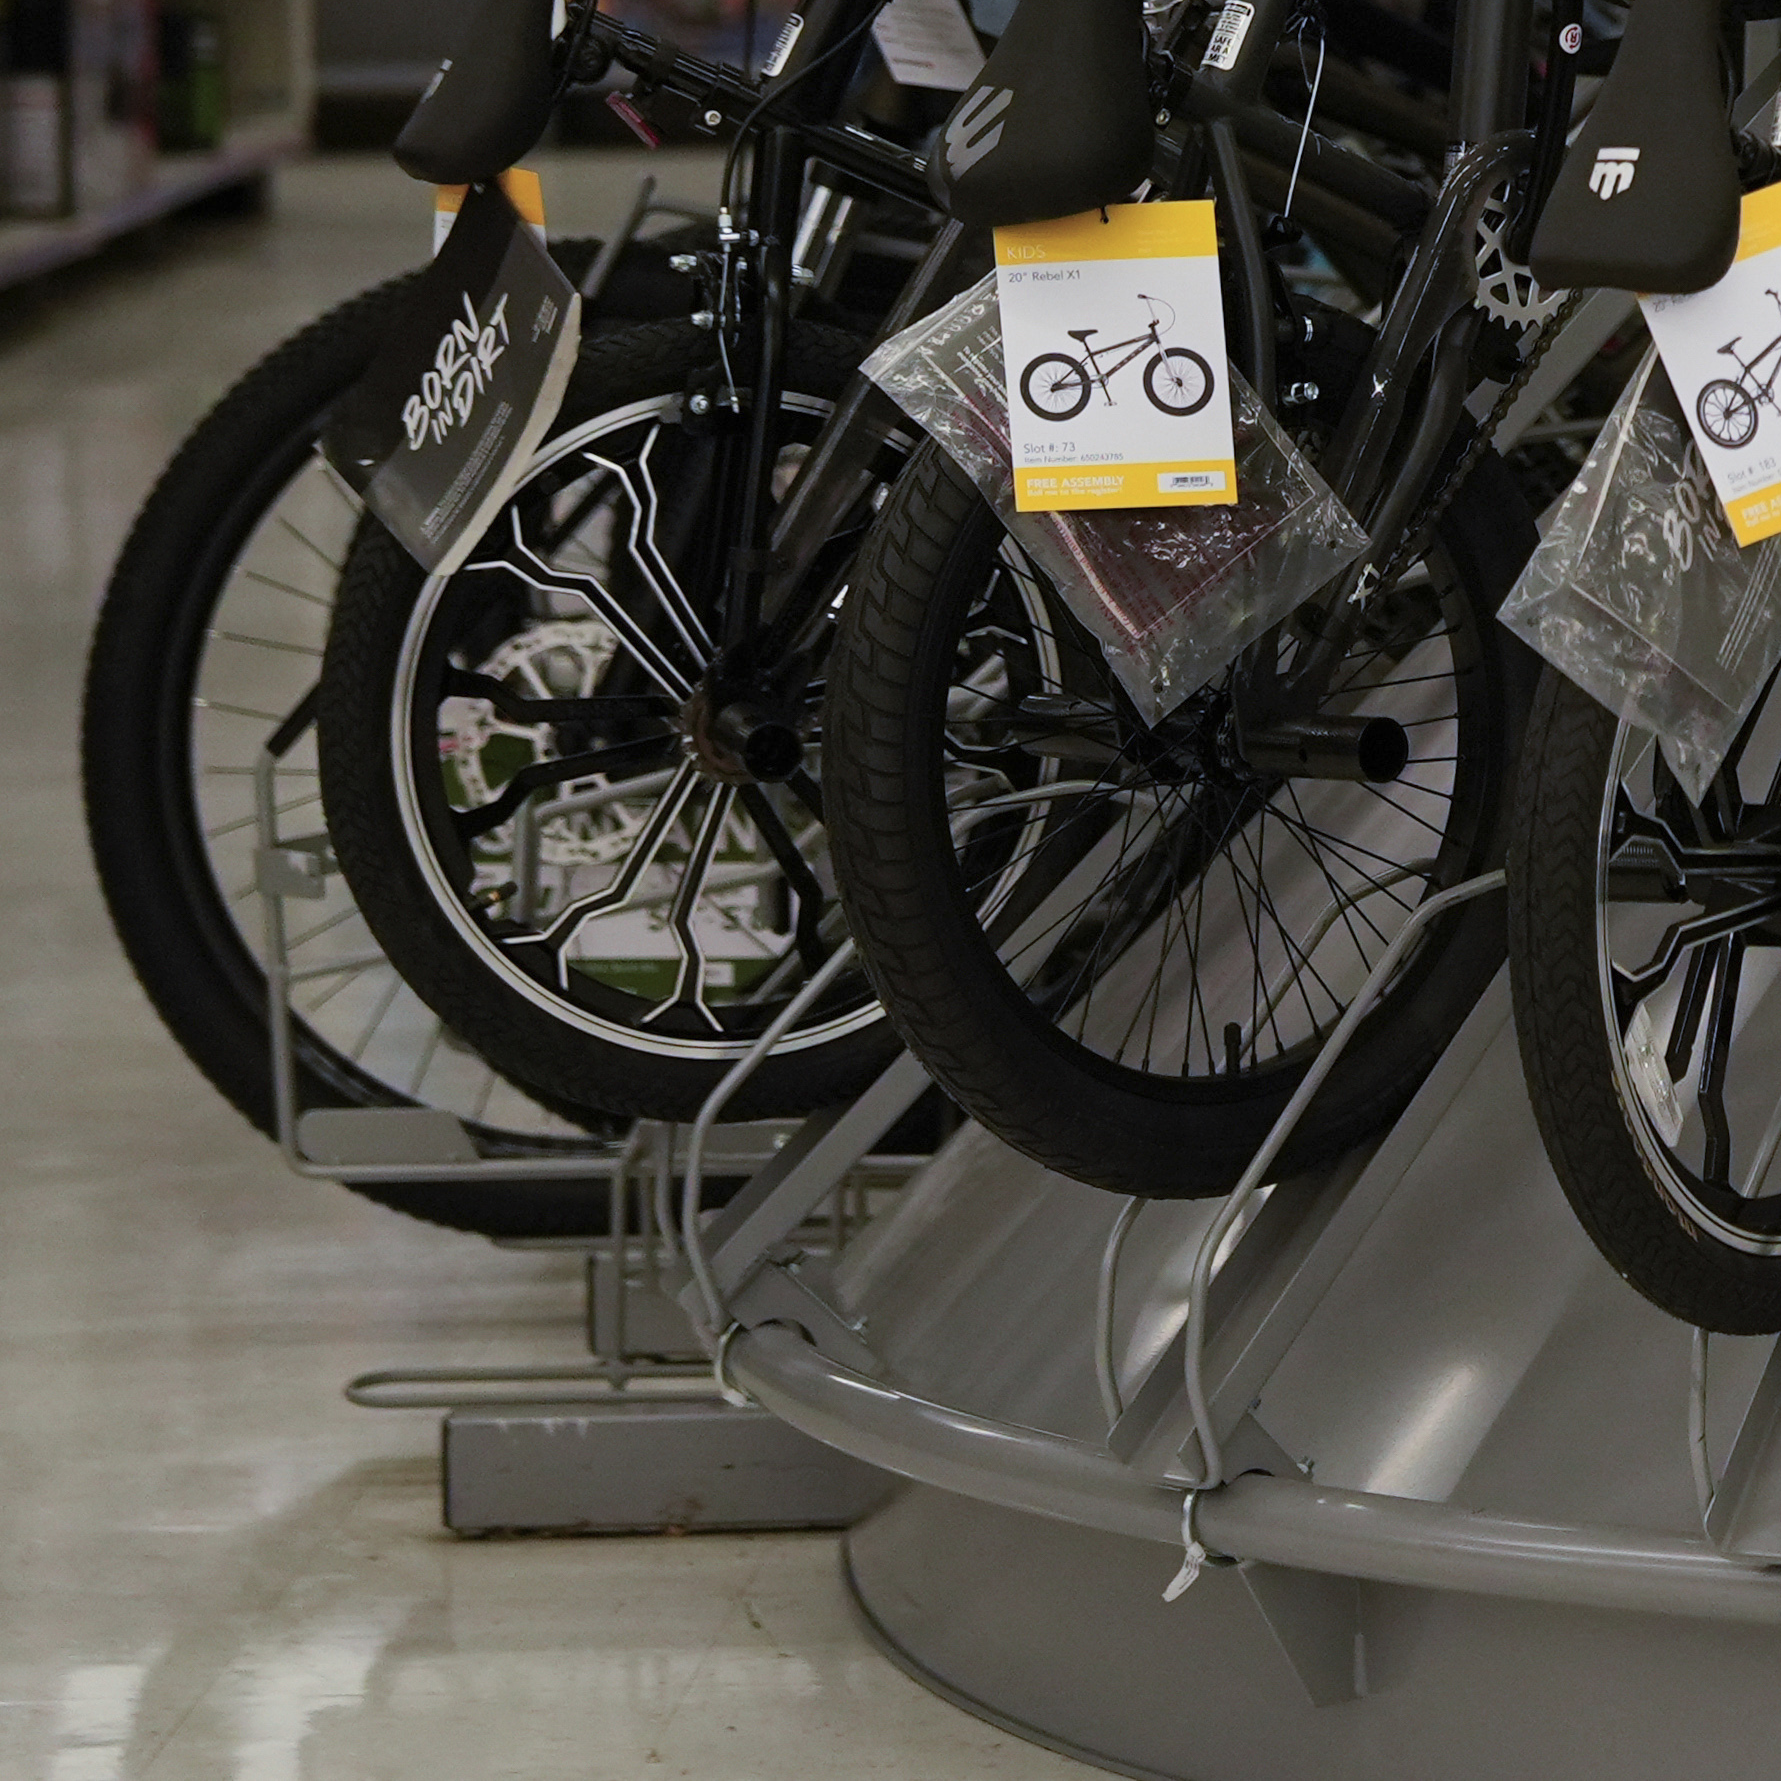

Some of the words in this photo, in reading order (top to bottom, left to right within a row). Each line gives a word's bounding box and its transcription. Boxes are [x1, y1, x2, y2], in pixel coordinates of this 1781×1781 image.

[1006, 245, 1047, 259] KIDS
[1032, 270, 1064, 282] Rebel
[1067, 269, 1081, 280] X1
[402, 290, 479, 451] BORN
[431, 396, 454, 445] IN
[452, 293, 510, 428] DIRT
[1023, 443, 1045, 454] Slot
[1062, 442, 1076, 452] 73
[1728, 470, 1745, 483] Slot
[1758, 458, 1776, 470] 183
[1027, 478, 1057, 489] FREE
[1061, 475, 1124, 487] ASSEMBLY
[1663, 440, 1710, 572] BOR
